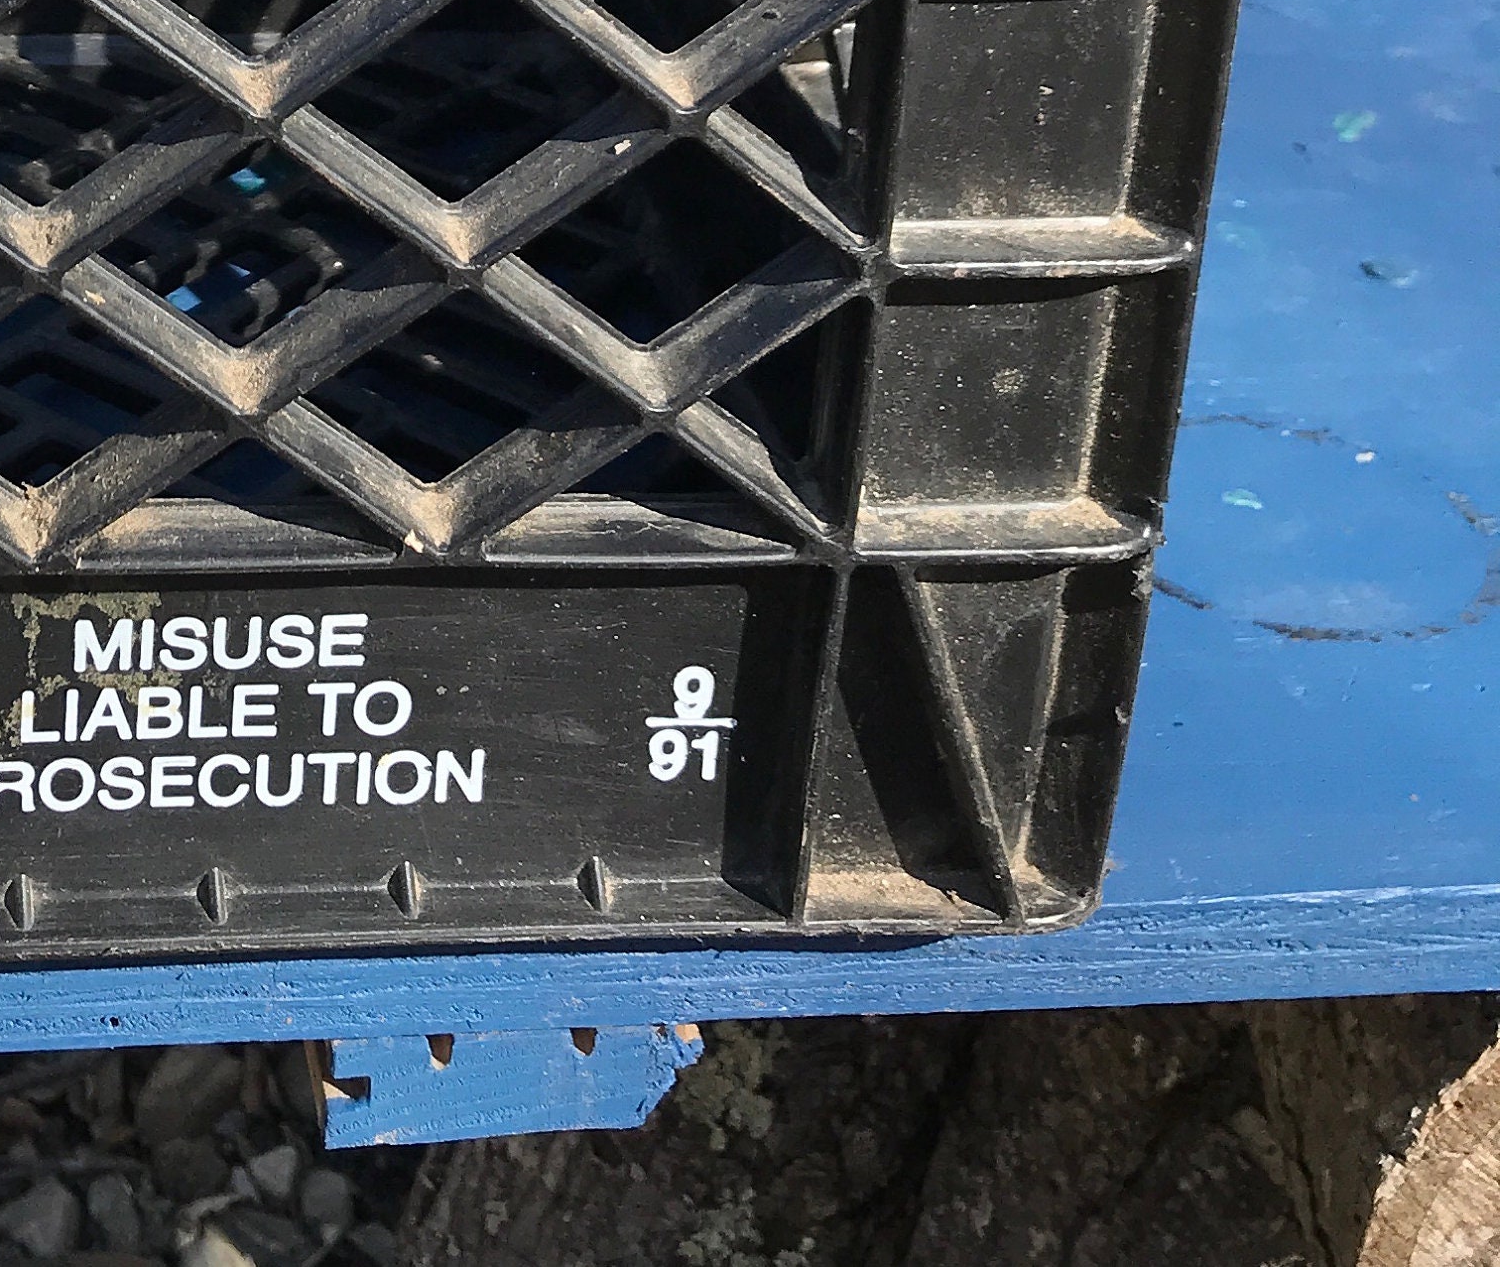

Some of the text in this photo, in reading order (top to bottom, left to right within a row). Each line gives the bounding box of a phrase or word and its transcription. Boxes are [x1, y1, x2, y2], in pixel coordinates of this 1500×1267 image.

[73, 613, 369, 673] MISUSE
[21, 680, 413, 744] LIABLE TO
[673, 665, 715, 720] 9
[648, 728, 719, 782] 91
